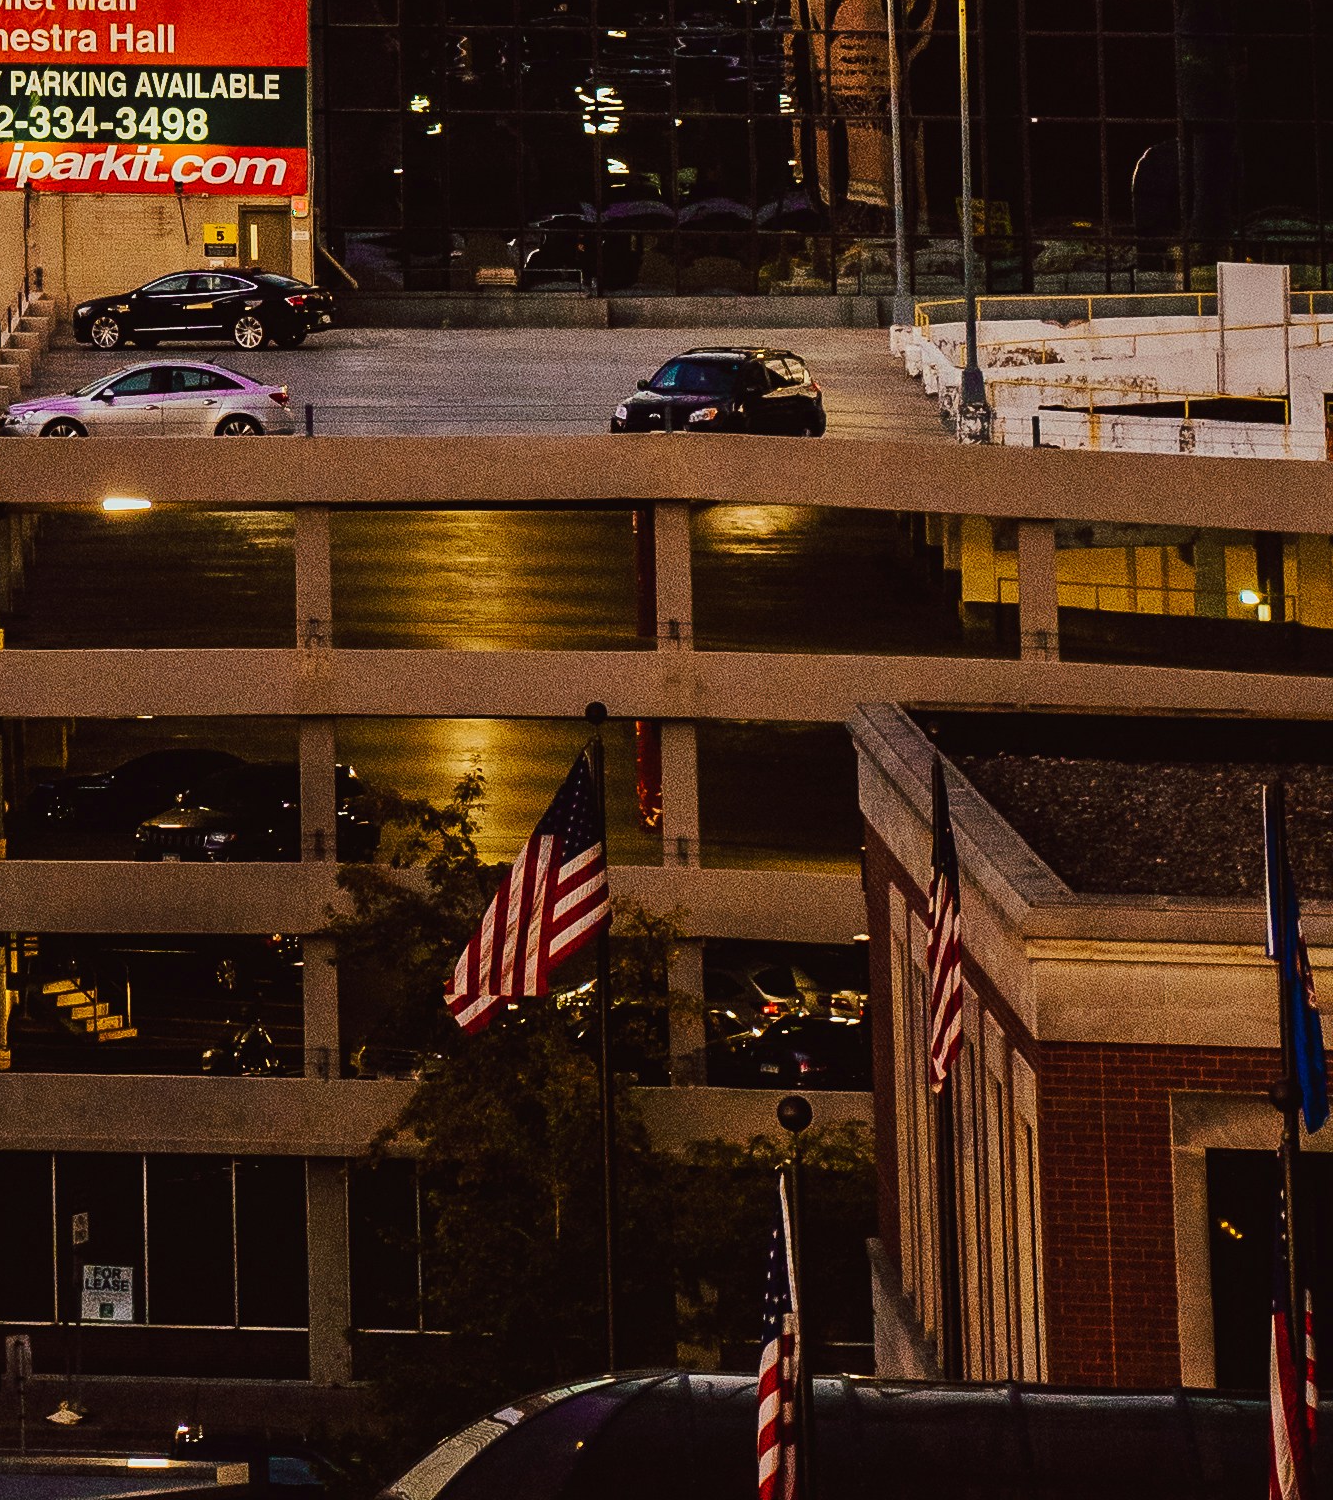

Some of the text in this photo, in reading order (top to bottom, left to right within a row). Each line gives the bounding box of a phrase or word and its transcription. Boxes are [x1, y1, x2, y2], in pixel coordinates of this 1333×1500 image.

[109, 23, 176, 53] Hall
[10, 70, 127, 98] PARKING
[134, 72, 280, 100] AVAILABLE
[216, 231, 225, 241] 5
[93, 1267, 122, 1280] FOR
[85, 1279, 130, 1292] LEASE
